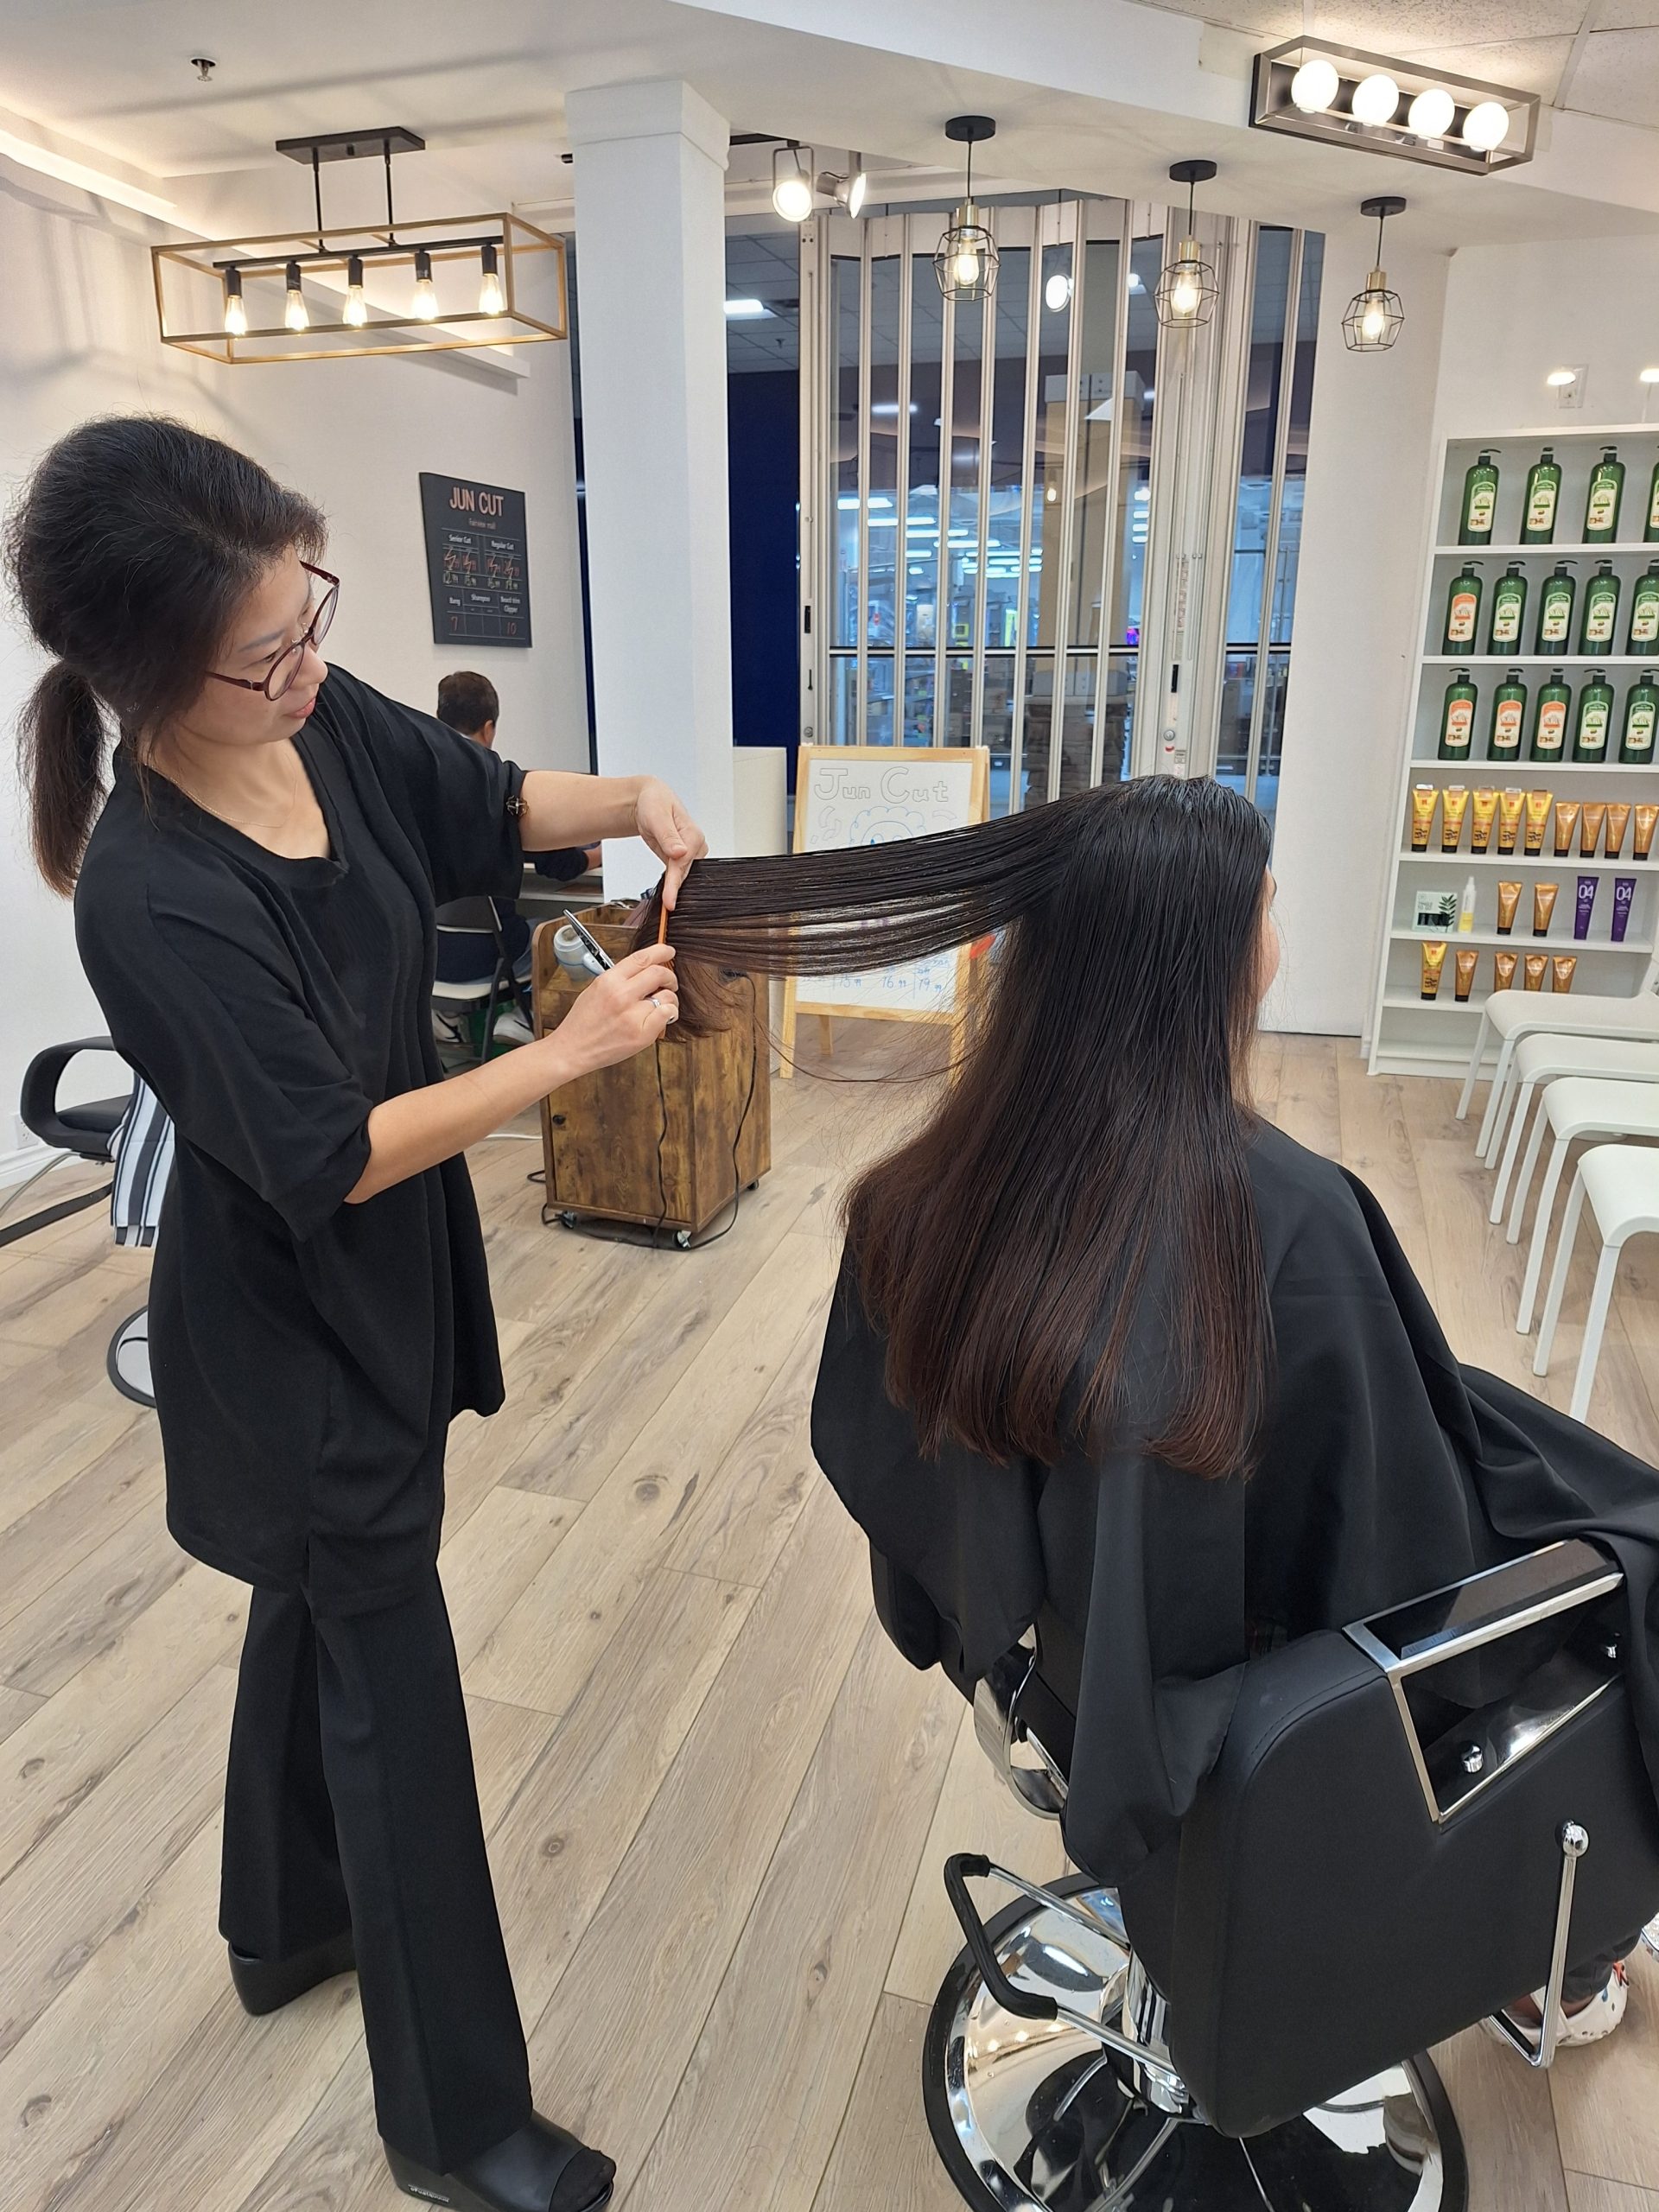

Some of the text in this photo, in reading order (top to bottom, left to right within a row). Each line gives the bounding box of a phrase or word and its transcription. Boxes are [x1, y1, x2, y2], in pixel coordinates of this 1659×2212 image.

[449, 486, 504, 517] JUN CUT
[463, 536, 472, 544] Cut
[507, 621, 517, 636] 10
[813, 766, 949, 804] Jun Cut
[1579, 884, 1594, 899] 04
[1616, 886, 1632, 901] 04
[882, 975, 894, 988] 16
